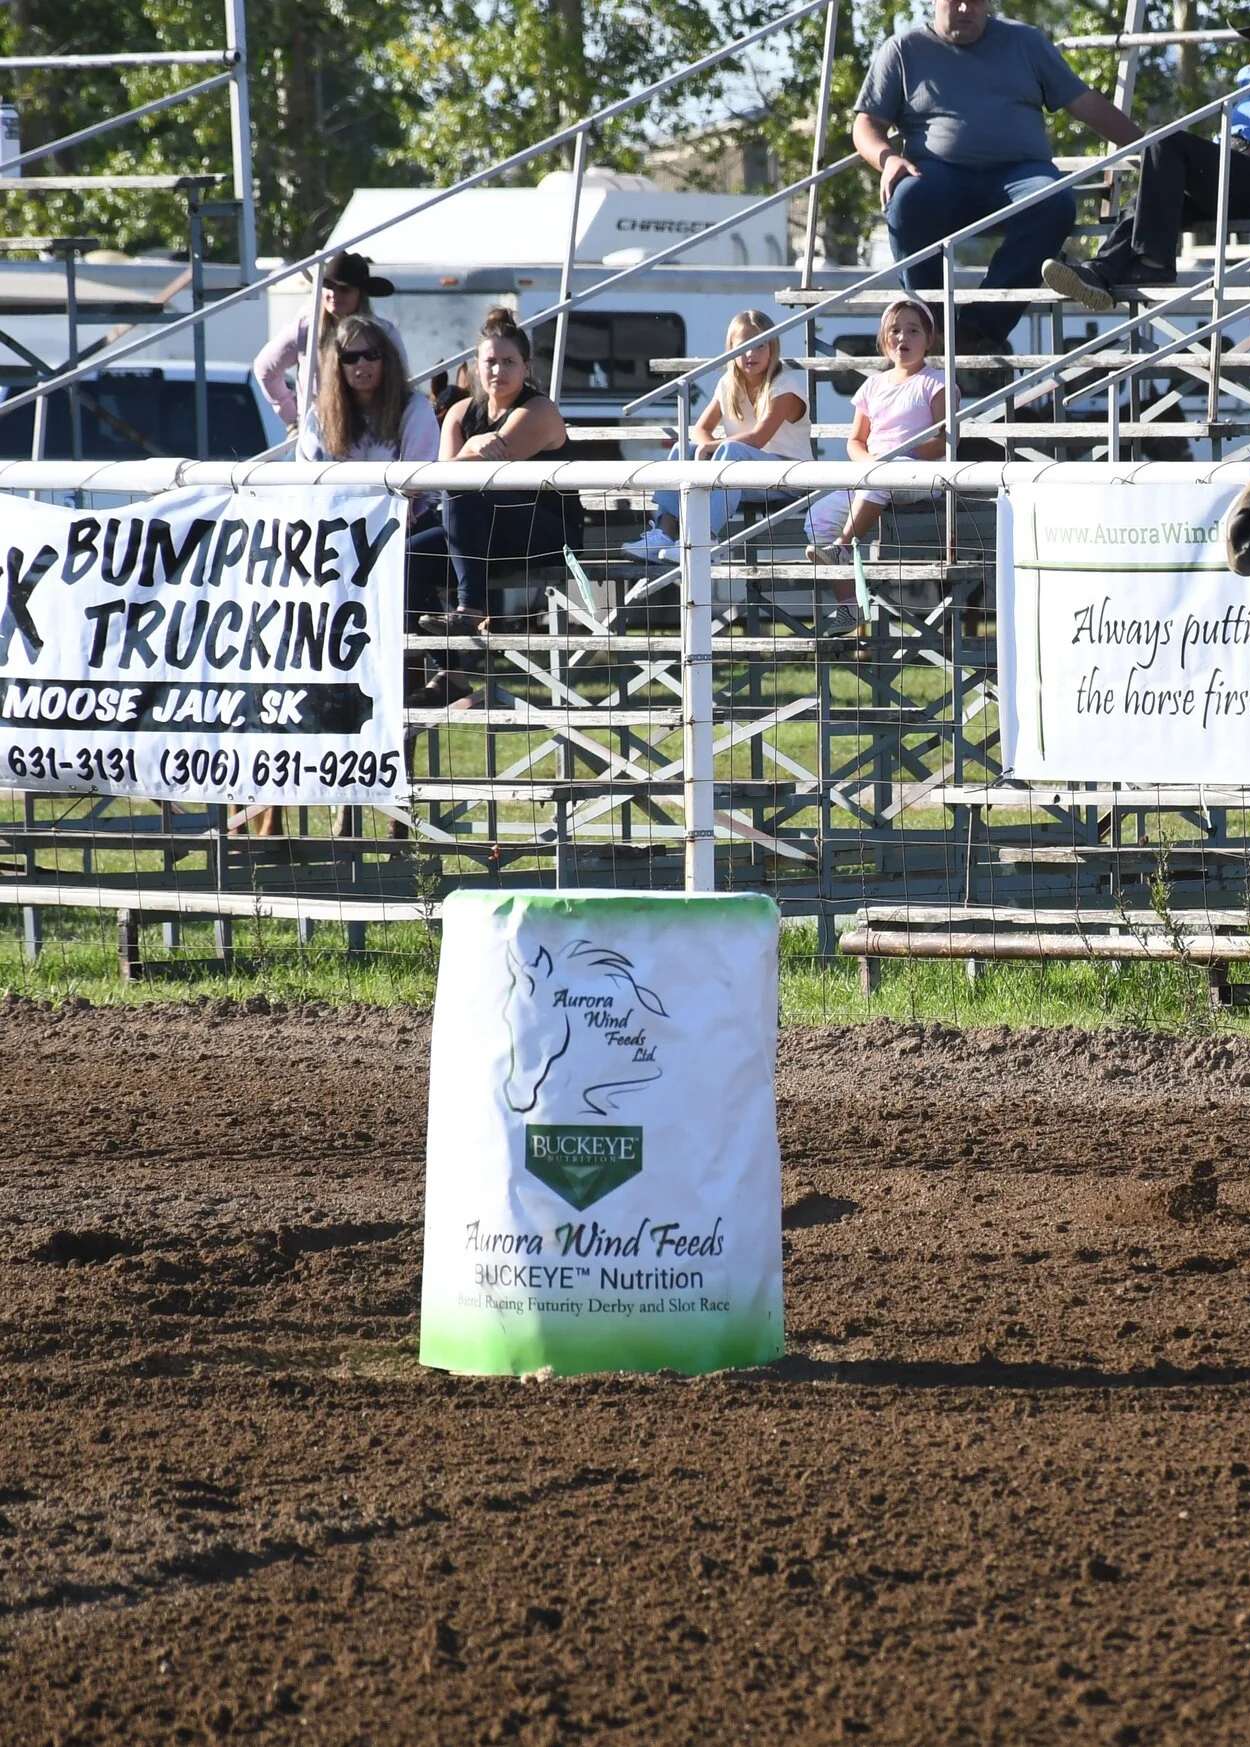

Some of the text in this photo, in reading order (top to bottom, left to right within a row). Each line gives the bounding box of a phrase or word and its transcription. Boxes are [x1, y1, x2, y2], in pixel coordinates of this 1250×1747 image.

[61, 517, 400, 587] BUMPHREY
[1044, 520, 1228, 544] www.AuroraWind
[0, 544, 59, 667] K
[85, 599, 371, 671] TRUCKING
[1072, 596, 1171, 668] Always
[2, 685, 308, 727] MOOSE JAW, SK
[1077, 666, 1114, 715] the
[1124, 666, 1195, 716] horse
[8, 745, 400, 788] 631-3131 (306) 631-9295
[552, 988, 614, 1009] Aurora
[584, 1009, 634, 1029] Wind
[605, 1028, 647, 1047] Feeds
[547, 1155, 616, 1163] NUTRITION
[466, 1217, 724, 1258] Aurora Wind Feeds
[600, 1267, 703, 1290] Nutrition
[485, 1295, 524, 1315] Racing
[528, 1297, 583, 1317] Futurity
[588, 1299, 634, 1317] Derby
[639, 1299, 665, 1313] and
[668, 1299, 696, 1313] Slot
[699, 1298, 730, 1312] Race
